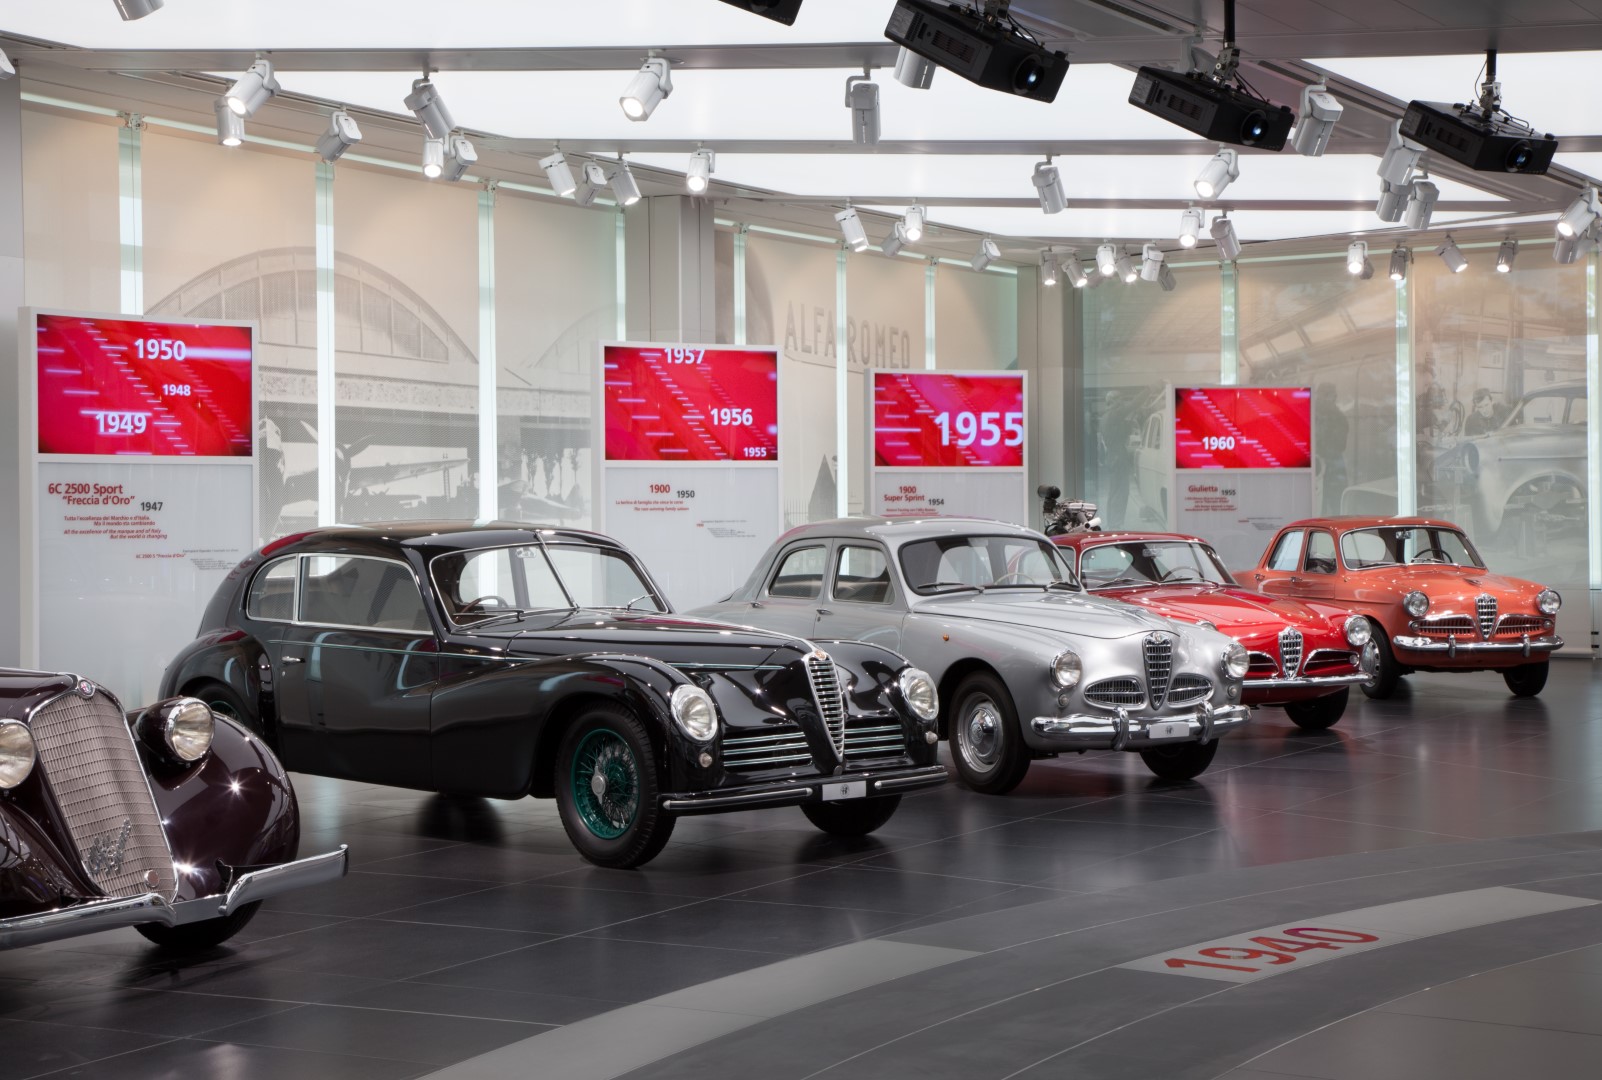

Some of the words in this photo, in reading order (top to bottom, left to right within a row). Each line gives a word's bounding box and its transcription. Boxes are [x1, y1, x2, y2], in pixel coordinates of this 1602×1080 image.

[785, 300, 837, 358] ALFA
[847, 315, 910, 369] ROMEO
[134, 338, 186, 361] 1950
[664, 347, 706, 364] 1957
[162, 384, 191, 396] 1948
[96, 411, 147, 433] 1949
[710, 408, 753, 425] 1956
[934, 411, 1024, 446] 1955
[1202, 436, 1235, 450] 1960
[743, 447, 767, 457] 1955
[48, 483, 62, 494] 6C
[64, 483, 90, 494] 2500
[93, 483, 123, 496] Sport
[649, 484, 671, 494] 1900
[677, 490, 695, 498] 1950
[899, 486, 917, 494] 1900
[1188, 485, 1218, 493] Giulietta
[62, 495, 100, 505] “Freccia
[102, 495, 135, 505] d’Oro”
[884, 494, 903, 502] Super
[905, 494, 925, 502] Sprint
[928, 498, 944, 506] 1954
[140, 501, 163, 512] 1947
[1164, 927, 1380, 972] 1940
